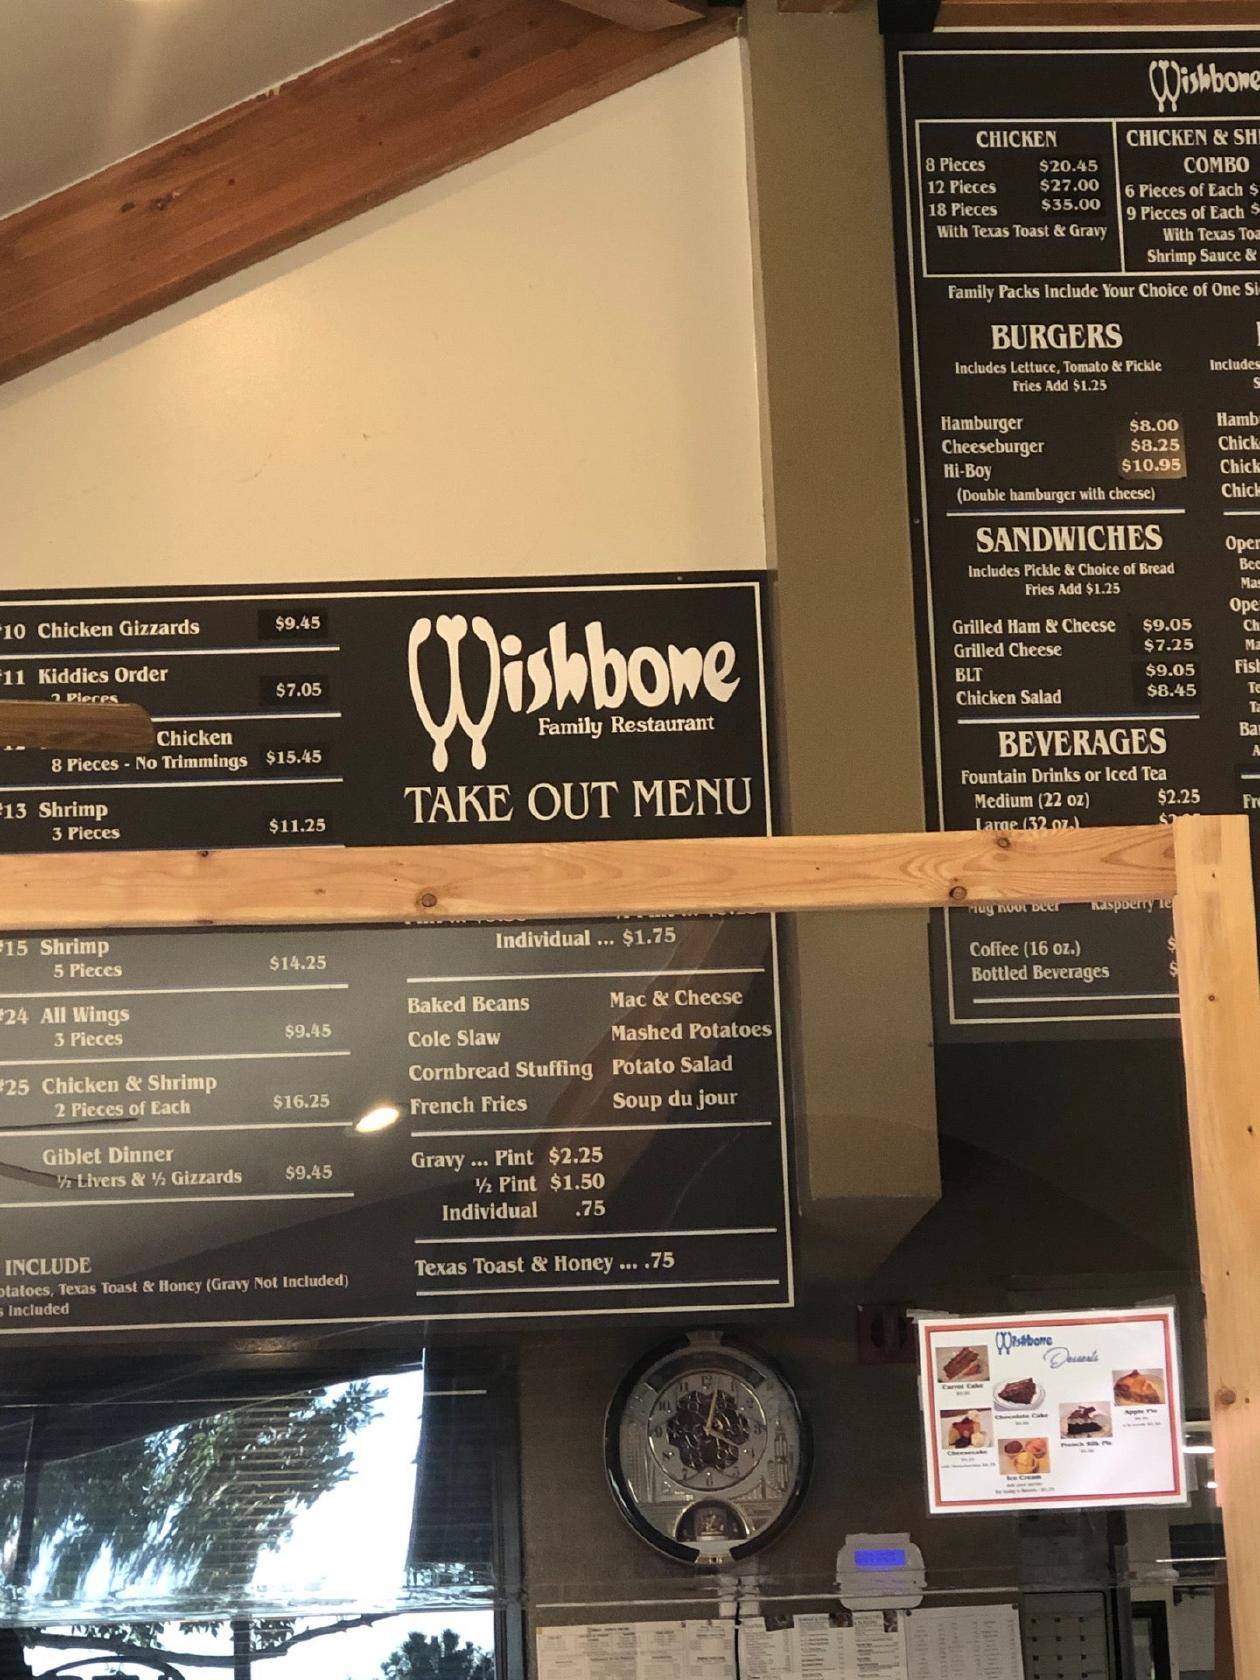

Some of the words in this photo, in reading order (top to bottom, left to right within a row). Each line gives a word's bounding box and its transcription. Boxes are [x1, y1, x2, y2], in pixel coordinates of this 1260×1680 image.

[1149, 59, 1260, 113] Wishbone
[976, 131, 1056, 147] CHICKEN
[926, 158, 935, 171] 8
[940, 158, 985, 171] Pieces
[1040, 160, 1098, 172] $20.45
[1184, 157, 1249, 173] COMBO
[928, 180, 944, 193] 12
[950, 180, 996, 193] Pieces
[1040, 179, 1099, 192] $27.00
[929, 203, 947, 216] 18
[952, 203, 997, 216] Pieces
[1042, 199, 1100, 211] $35.00
[937, 225, 968, 237] With
[972, 225, 1009, 237] Texas
[1013, 225, 1049, 237] Toast
[1054, 224, 1066, 237] &
[1070, 224, 1107, 240] Gravy
[992, 324, 1122, 349] BURGERS
[956, 361, 1006, 374] Includes
[1011, 362, 1060, 374] Lettuce,
[1063, 361, 1108, 372] Tomato
[1112, 360, 1122, 372] &
[1126, 360, 1162, 371] Pickle
[1013, 381, 1042, 391] Fries
[1046, 380, 1068, 391] Add
[1074, 379, 1107, 392] $1.25
[942, 416, 1023, 433] Hamburger
[1130, 419, 1179, 432] $8.00
[942, 439, 1044, 457] Cheeseburger
[1132, 439, 1180, 452] $8.25
[944, 464, 991, 481] Hi-Boy
[1122, 458, 1181, 472] $10.95
[957, 488, 1005, 504] (Double
[1010, 488, 1076, 503] hamburger
[1080, 487, 1105, 500] with
[1109, 487, 1155, 501] cheese)
[977, 525, 1162, 552] SANDWICHES
[969, 565, 1020, 577] Includes
[1024, 564, 1060, 576] Pickle
[1065, 564, 1075, 576] &
[1078, 563, 1119, 575] Choice
[1123, 563, 1136, 575] of
[1140, 563, 1174, 574] Bread
[1026, 584, 1054, 595] Fries
[1059, 583, 1082, 595] Add
[1086, 583, 1120, 595] $1.25
[38, 622, 112, 638] Chicken
[120, 619, 199, 636] Gizzards
[276, 616, 320, 631] $9.45
[953, 619, 1003, 634] Grilled
[1008, 620, 1040, 633] Ham
[1046, 619, 1058, 633] &
[1062, 618, 1115, 633] Cheese
[1144, 619, 1192, 632] $9.05
[954, 643, 1004, 658] Grilled
[1009, 642, 1062, 657] Cheese
[1145, 639, 1193, 652] $7.25
[39, 668, 108, 684] Kiddies
[115, 666, 168, 682] Order
[277, 683, 321, 697] $7.05
[956, 668, 982, 682] BLT
[1146, 664, 1195, 677] $9.05
[408, 615, 740, 772] Wishbone
[956, 690, 1016, 705] Chicken
[1021, 689, 1061, 704] Salad
[1148, 684, 1196, 697] $8.45
[539, 717, 602, 739] Family
[611, 716, 714, 732] Restaurant
[157, 730, 232, 746] Chicken
[998, 728, 1166, 757] BEVERAGES
[52, 759, 62, 772] 8
[68, 758, 119, 771] Pieces
[136, 757, 157, 769] No
[162, 754, 247, 771] Trimmings
[267, 749, 321, 765] $15.45
[962, 769, 1026, 784] Fountain
[1032, 767, 1081, 782] Drinks
[1085, 771, 1101, 781] or
[1106, 766, 1137, 781] Iced
[1142, 766, 1166, 780] Tea
[404, 785, 513, 823] TAKE
[528, 782, 618, 820] OUT
[633, 778, 751, 817] MENU
[975, 793, 1033, 808] Medium
[1039, 792, 1061, 809] (22
[1067, 792, 1089, 808] oz)
[1159, 789, 1200, 805] $2.25
[39, 801, 108, 821] Shrimp
[53, 828, 62, 840] 3
[68, 827, 120, 840] Pieces
[270, 819, 325, 834] $11.25
[41, 938, 109, 957] Shrimp
[970, 941, 1019, 956] Coffee
[1024, 941, 1048, 958] (16
[1053, 941, 1080, 956] oz.)
[54, 964, 64, 978] 5
[70, 963, 122, 977] Pieces
[270, 956, 326, 970] $14.25
[972, 965, 1027, 981] Bottled
[1033, 965, 1109, 983] Beverages
[408, 996, 465, 1013] Baked
[473, 996, 529, 1011] Beans
[610, 992, 646, 1007] Mac
[653, 991, 668, 1006] &
[675, 990, 742, 1005] Cheese
[41, 1007, 66, 1023] All
[73, 1006, 129, 1026] Wings
[54, 1033, 64, 1047] 3
[71, 1032, 123, 1046] Pieces
[286, 1024, 331, 1039] $9.45
[408, 1031, 450, 1047] Cole
[457, 1029, 500, 1046] Slaw
[612, 1023, 682, 1040] Mashed
[689, 1023, 772, 1039] Potatoes
[409, 1062, 509, 1081] Cornbread
[516, 1060, 593, 1080] Stuffing
[613, 1058, 674, 1074] Potato
[681, 1055, 732, 1072] Salad
[42, 1077, 118, 1094] Chicken
[126, 1076, 142, 1091] &
[148, 1074, 217, 1094] Shrimp
[274, 1094, 329, 1110] $16.25
[613, 1093, 662, 1111] Soup
[668, 1090, 692, 1106] du
[697, 1089, 738, 1110] jour
[55, 1103, 65, 1117] 2
[72, 1103, 123, 1117] Pieces
[129, 1101, 146, 1115] of
[151, 1100, 190, 1114] Each
[411, 1097, 473, 1114] French
[482, 1096, 527, 1112] Fries
[43, 1148, 101, 1165] Giblet
[109, 1146, 173, 1163] Dinner
[286, 1165, 332, 1180] $9.45
[6, 1257, 91, 1276] INCLUDE
[415, 1260, 467, 1276] Texas
[473, 1257, 524, 1273] Toast
[532, 1256, 547, 1272] &
[555, 1256, 613, 1274] Honey
[645, 1252, 674, 1268] .75
